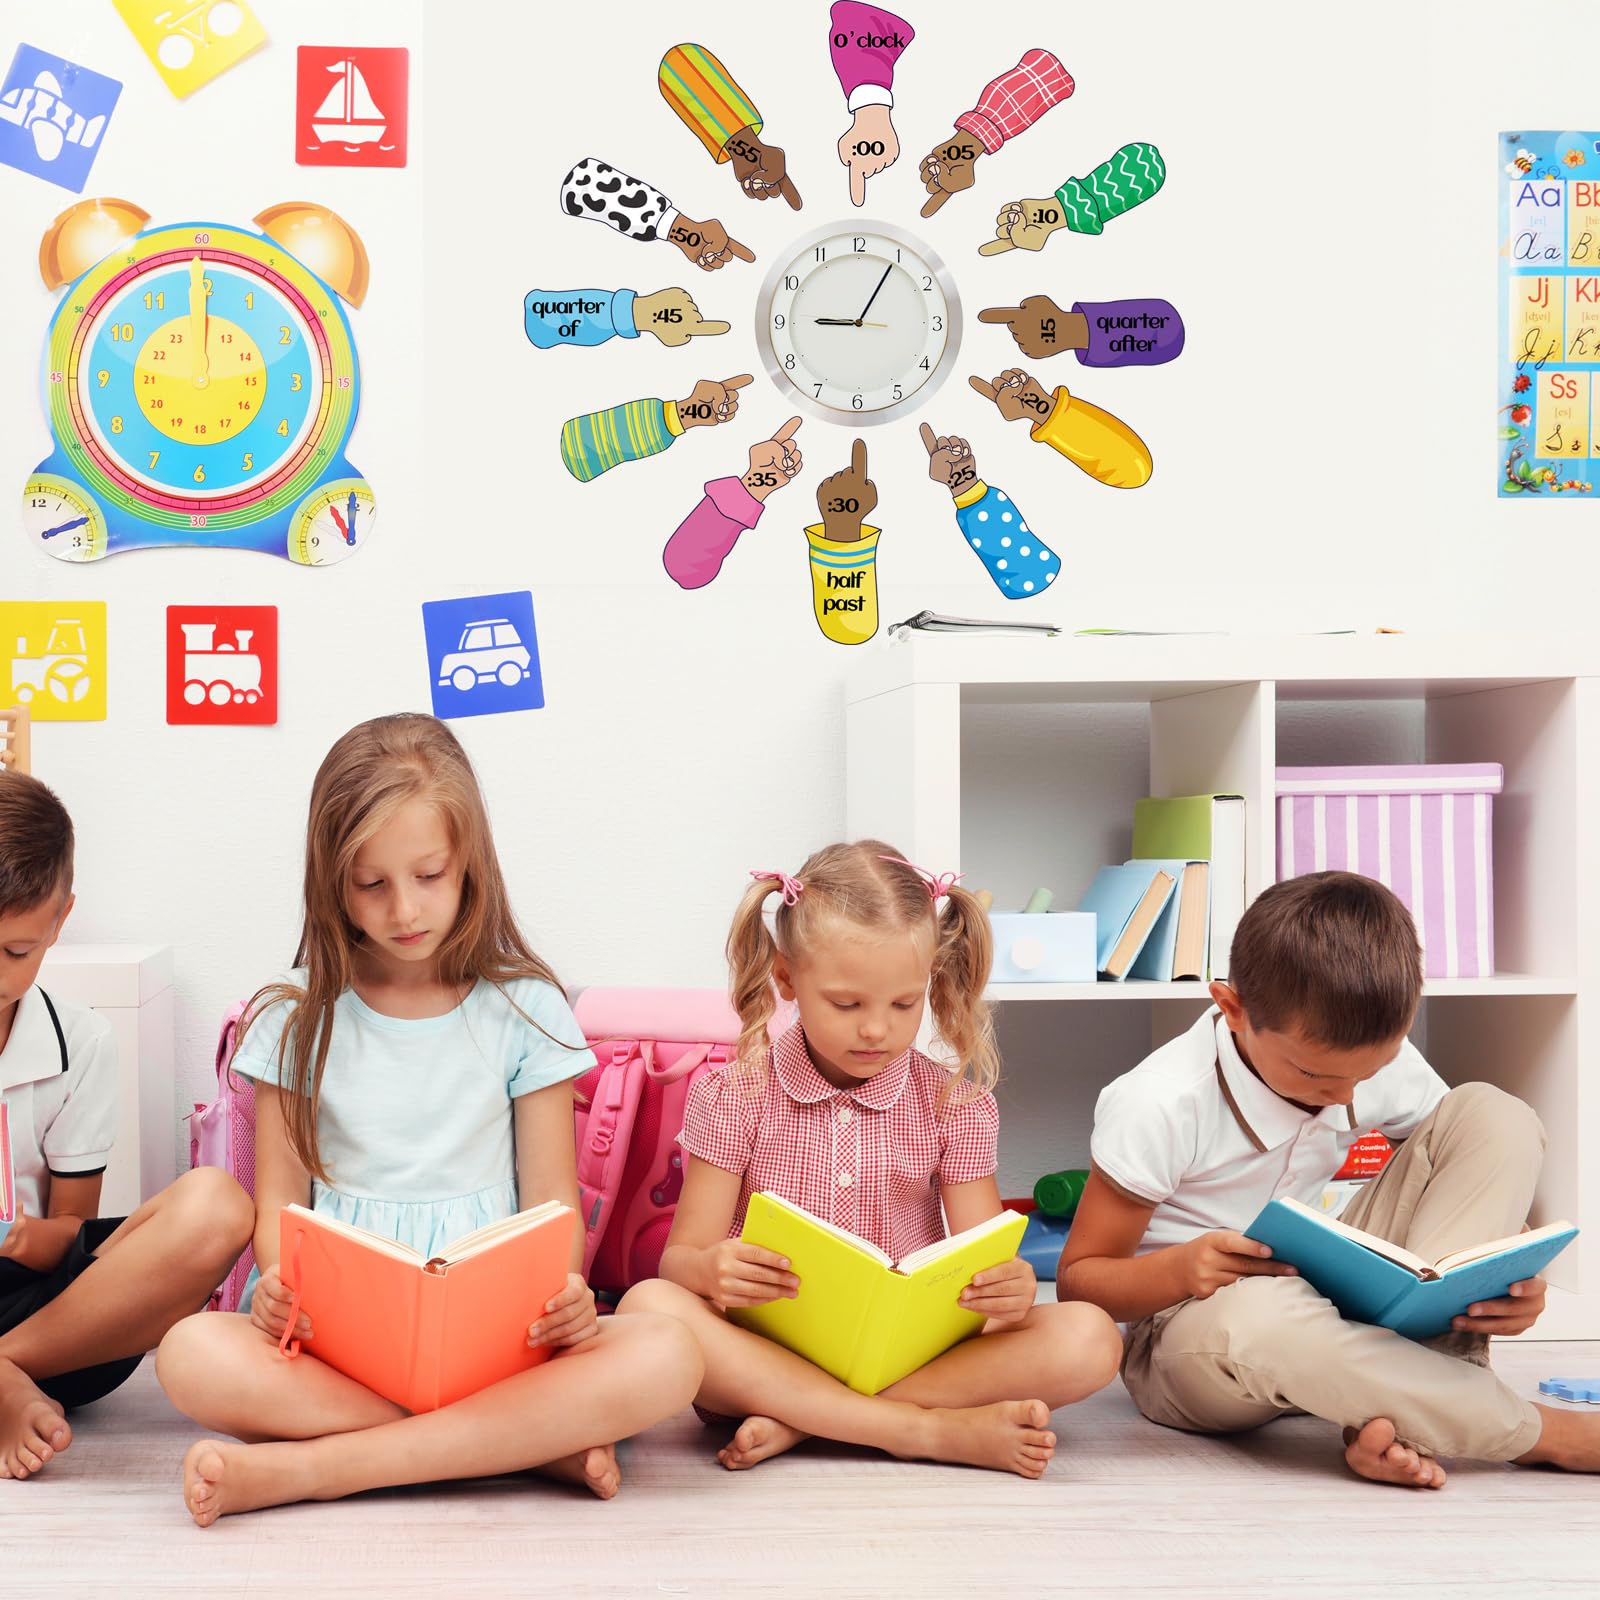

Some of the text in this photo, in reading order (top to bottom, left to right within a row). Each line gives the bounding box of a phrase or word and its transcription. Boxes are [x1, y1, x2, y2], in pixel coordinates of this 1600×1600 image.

[728, 140, 760, 163] :55
[852, 141, 885, 156] :00
[943, 145, 975, 161] :05
[1516, 182, 1560, 207] Aa
[1032, 209, 1058, 224] :10
[195, 234, 209, 244] 60
[670, 227, 700, 247] :50
[853, 237, 866, 252] 12
[815, 247, 826, 262] 11
[896, 249, 901, 263] 1
[785, 275, 799, 291] 10
[923, 276, 932, 291] 2
[143, 292, 165, 310] 11
[245, 292, 253, 310] 1
[1528, 278, 1548, 308] Jj
[532, 298, 605, 318] quarter
[653, 309, 683, 323] :45
[558, 320, 581, 337] of
[774, 314, 785, 330] 9
[932, 315, 943, 331] 3
[1097, 313, 1170, 333] quarter
[111, 323, 134, 342] 10
[279, 327, 291, 344] 2
[1041, 318, 1055, 343] :15
[170, 334, 182, 344] 23
[221, 334, 232, 344] 13
[1109, 335, 1157, 352] after
[153, 351, 166, 360] 22
[240, 352, 251, 362] 14
[785, 353, 796, 370] 8
[919, 356, 930, 371] 4
[50, 373, 63, 383] 45
[97, 371, 110, 388] 9
[144, 375, 156, 385] 21
[245, 377, 257, 386] 15
[290, 374, 302, 391] 3
[338, 378, 350, 388] 15
[1550, 374, 1577, 398] Ss
[813, 383, 823, 398] 7
[892, 384, 902, 400] 5
[151, 399, 163, 409] 20
[238, 401, 250, 411] 16
[852, 394, 863, 410] 6
[1023, 393, 1049, 414] :20
[680, 404, 711, 419] :40
[111, 417, 123, 433] 8
[171, 418, 183, 427] 19
[195, 425, 206, 434] 18
[220, 418, 231, 428] 17
[276, 420, 289, 436] 4
[149, 452, 160, 470] 7
[242, 453, 253, 471] 5
[194, 465, 205, 482] 6
[748, 473, 777, 487] :35
[947, 465, 976, 489] :25
[31, 498, 47, 508] 12
[828, 498, 859, 513] :30
[191, 516, 206, 527] 30
[72, 536, 82, 547] 3
[311, 536, 320, 547] 9
[827, 571, 866, 589] half
[824, 596, 866, 615] past
